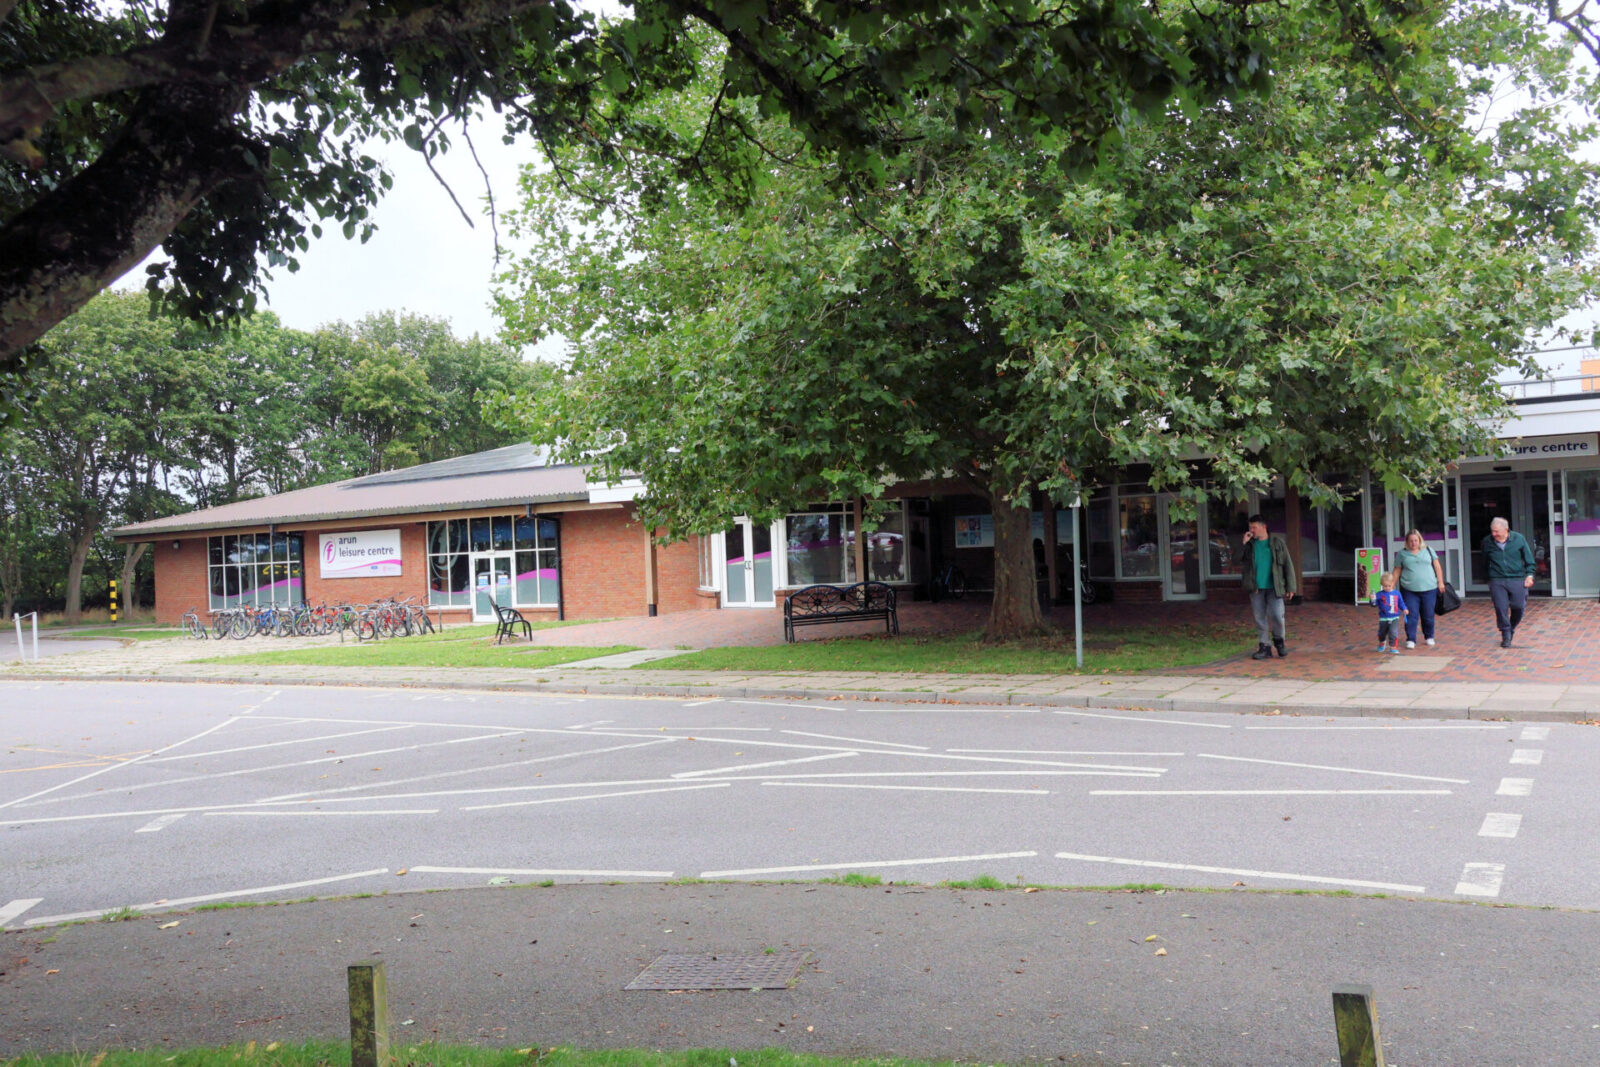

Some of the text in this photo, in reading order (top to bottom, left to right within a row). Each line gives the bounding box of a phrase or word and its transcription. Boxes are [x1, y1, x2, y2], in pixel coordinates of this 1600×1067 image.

[1542, 441, 1588, 452] centre
[338, 536, 357, 544] arun
[339, 546, 394, 558] leisure centre
